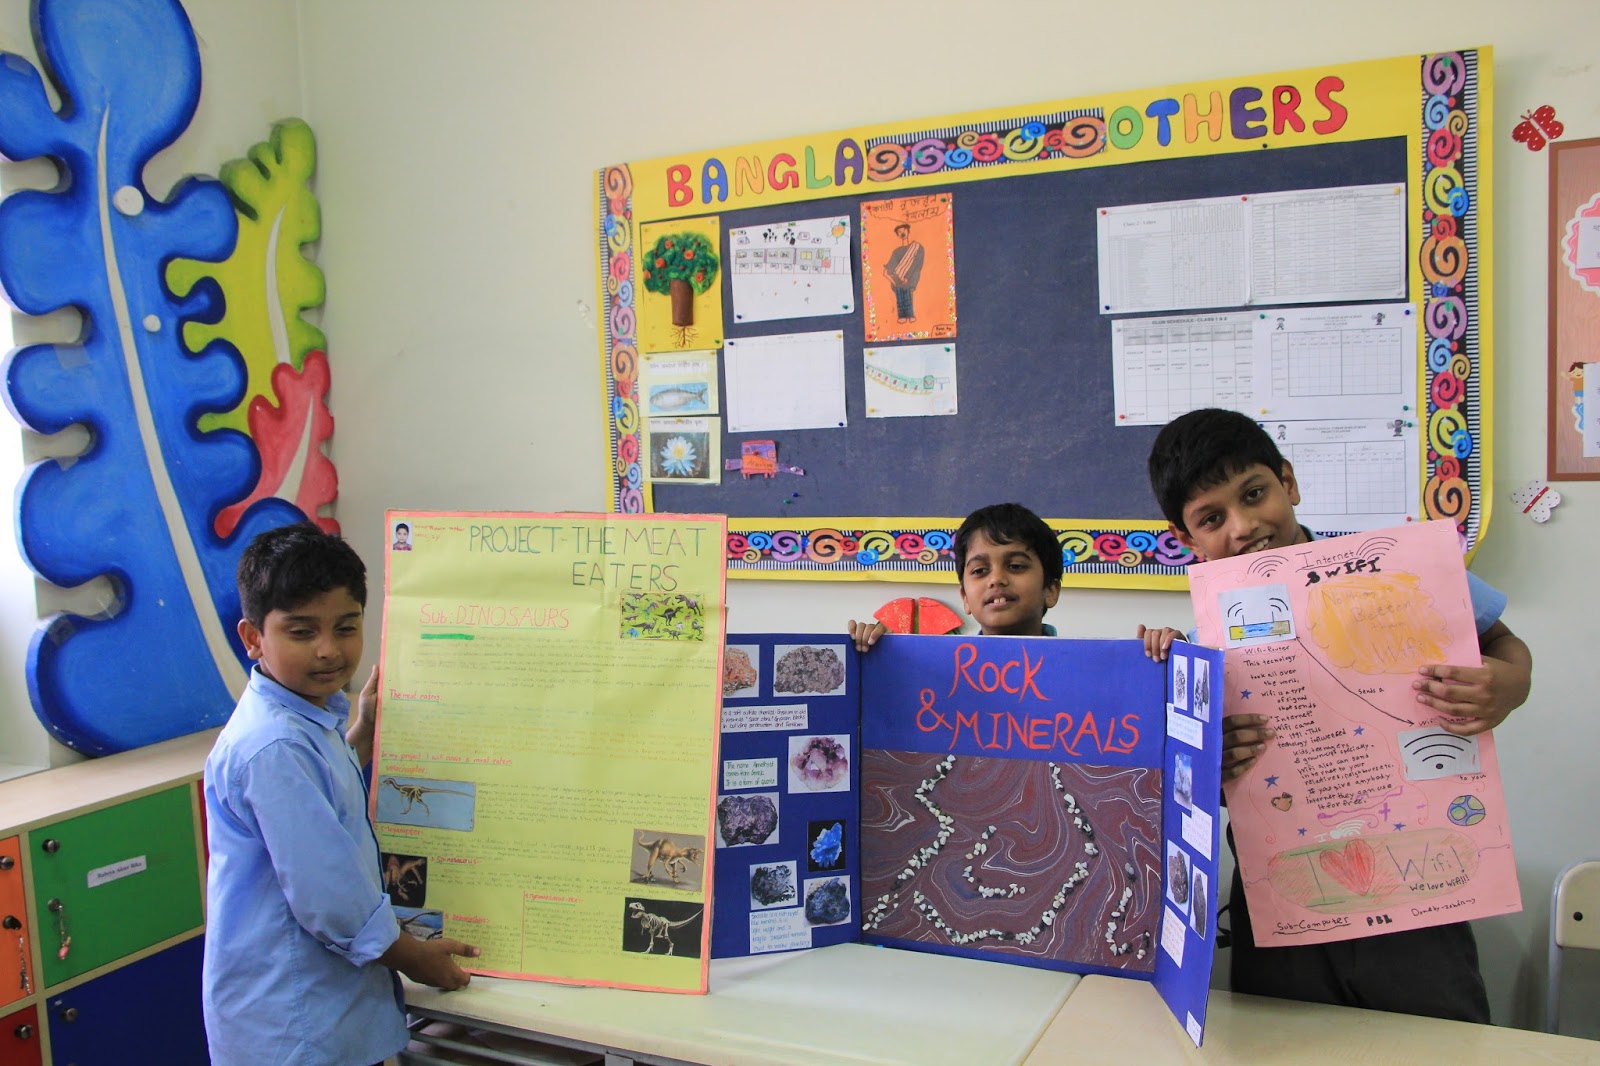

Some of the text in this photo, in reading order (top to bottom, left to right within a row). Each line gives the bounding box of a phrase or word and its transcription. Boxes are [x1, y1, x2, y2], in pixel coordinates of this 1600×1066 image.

[1108, 75, 1348, 150] OTHERS
[666, 138, 864, 208] BANGLA
[572, 526, 617, 555] THE
[624, 527, 707, 556] MEAT
[1296, 549, 1355, 567] Internet
[572, 562, 680, 591] EATERS
[1243, 659, 1260, 667] This
[1267, 671, 1278, 679] all
[916, 688, 953, 732] &
[948, 710, 1140, 757] MINERALS
[1318, 761, 1333, 769] also
[1348, 762, 1365, 773] your
[1427, 882, 1444, 890] love
